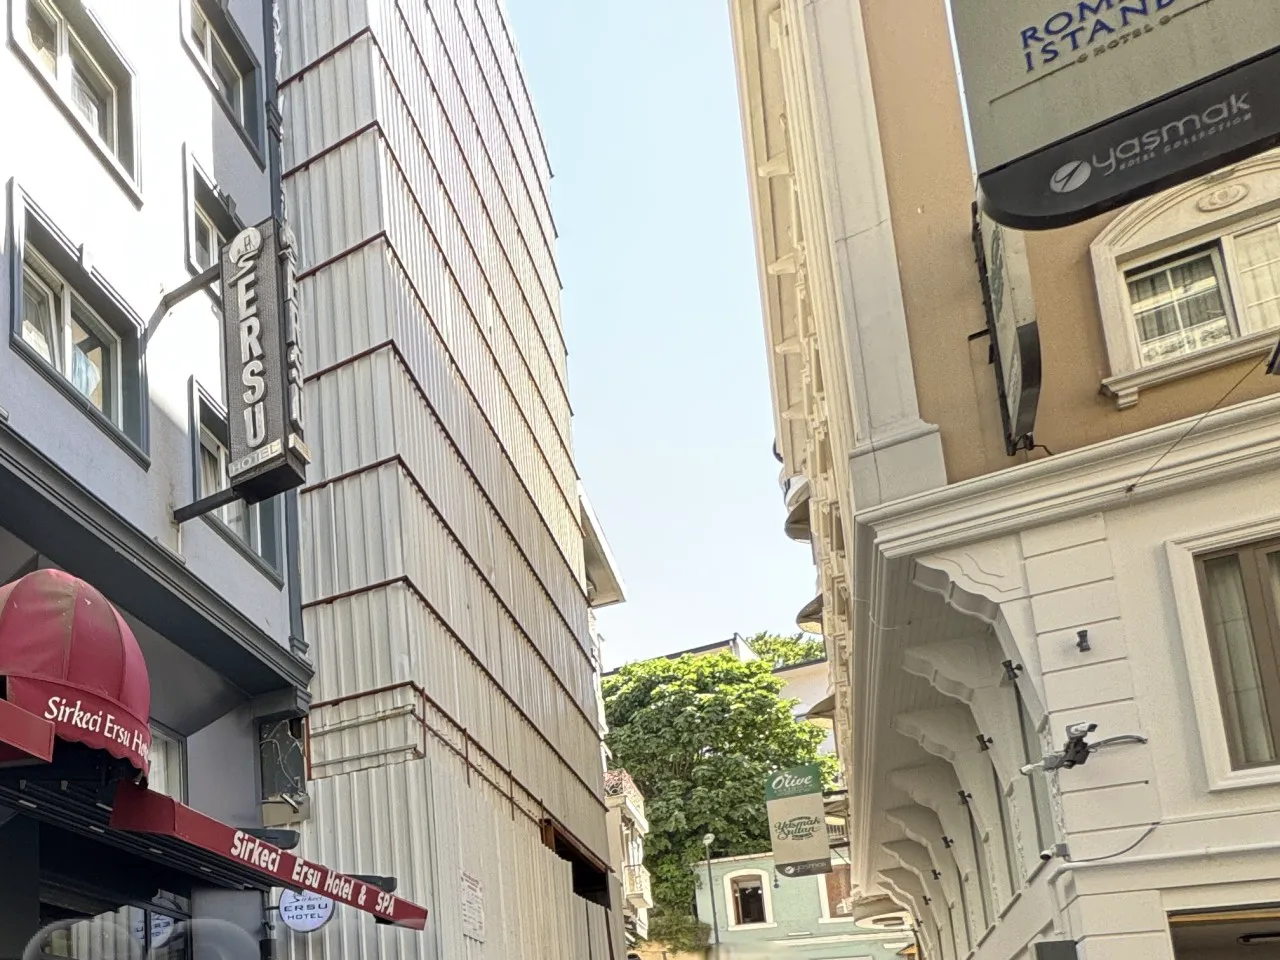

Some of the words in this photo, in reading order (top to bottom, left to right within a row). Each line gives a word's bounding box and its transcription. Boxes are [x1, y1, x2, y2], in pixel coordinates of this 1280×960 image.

[230, 439, 281, 475] HOTEL
[45, 697, 102, 732] Sirkeci
[104, 714, 130, 747] Ersu
[772, 773, 813, 789] Olive
[231, 831, 281, 872] Sirkeci
[291, 857, 321, 888] Ersu
[324, 870, 354, 901] Hotel
[358, 887, 367, 906] &
[375, 892, 395, 916] SPA
[284, 902, 328, 912] ERSU
